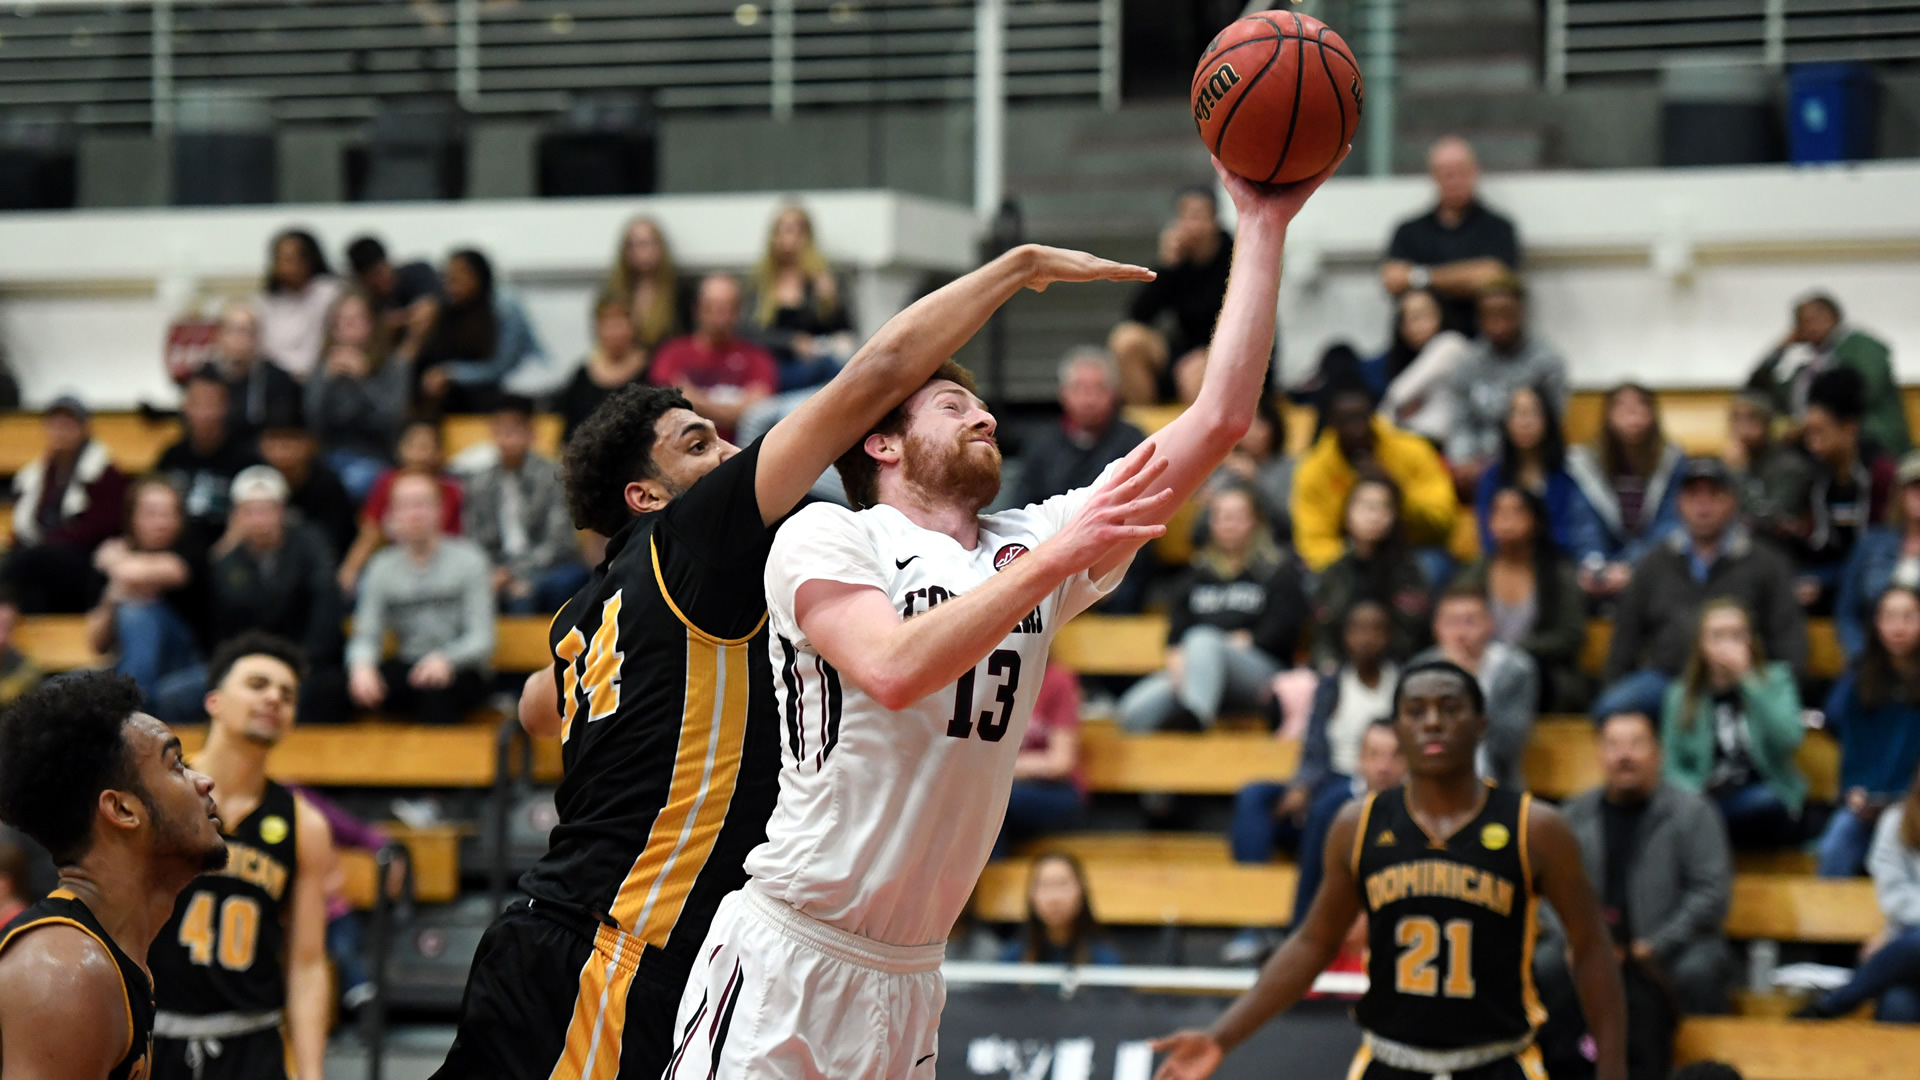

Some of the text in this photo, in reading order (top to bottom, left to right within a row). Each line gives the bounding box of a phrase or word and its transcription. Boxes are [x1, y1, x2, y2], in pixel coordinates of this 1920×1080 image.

[946, 649, 1022, 743] 13
[1366, 860, 1515, 917] DOMINICAN
[178, 891, 260, 971] 40
[1396, 917, 1475, 998] 21
